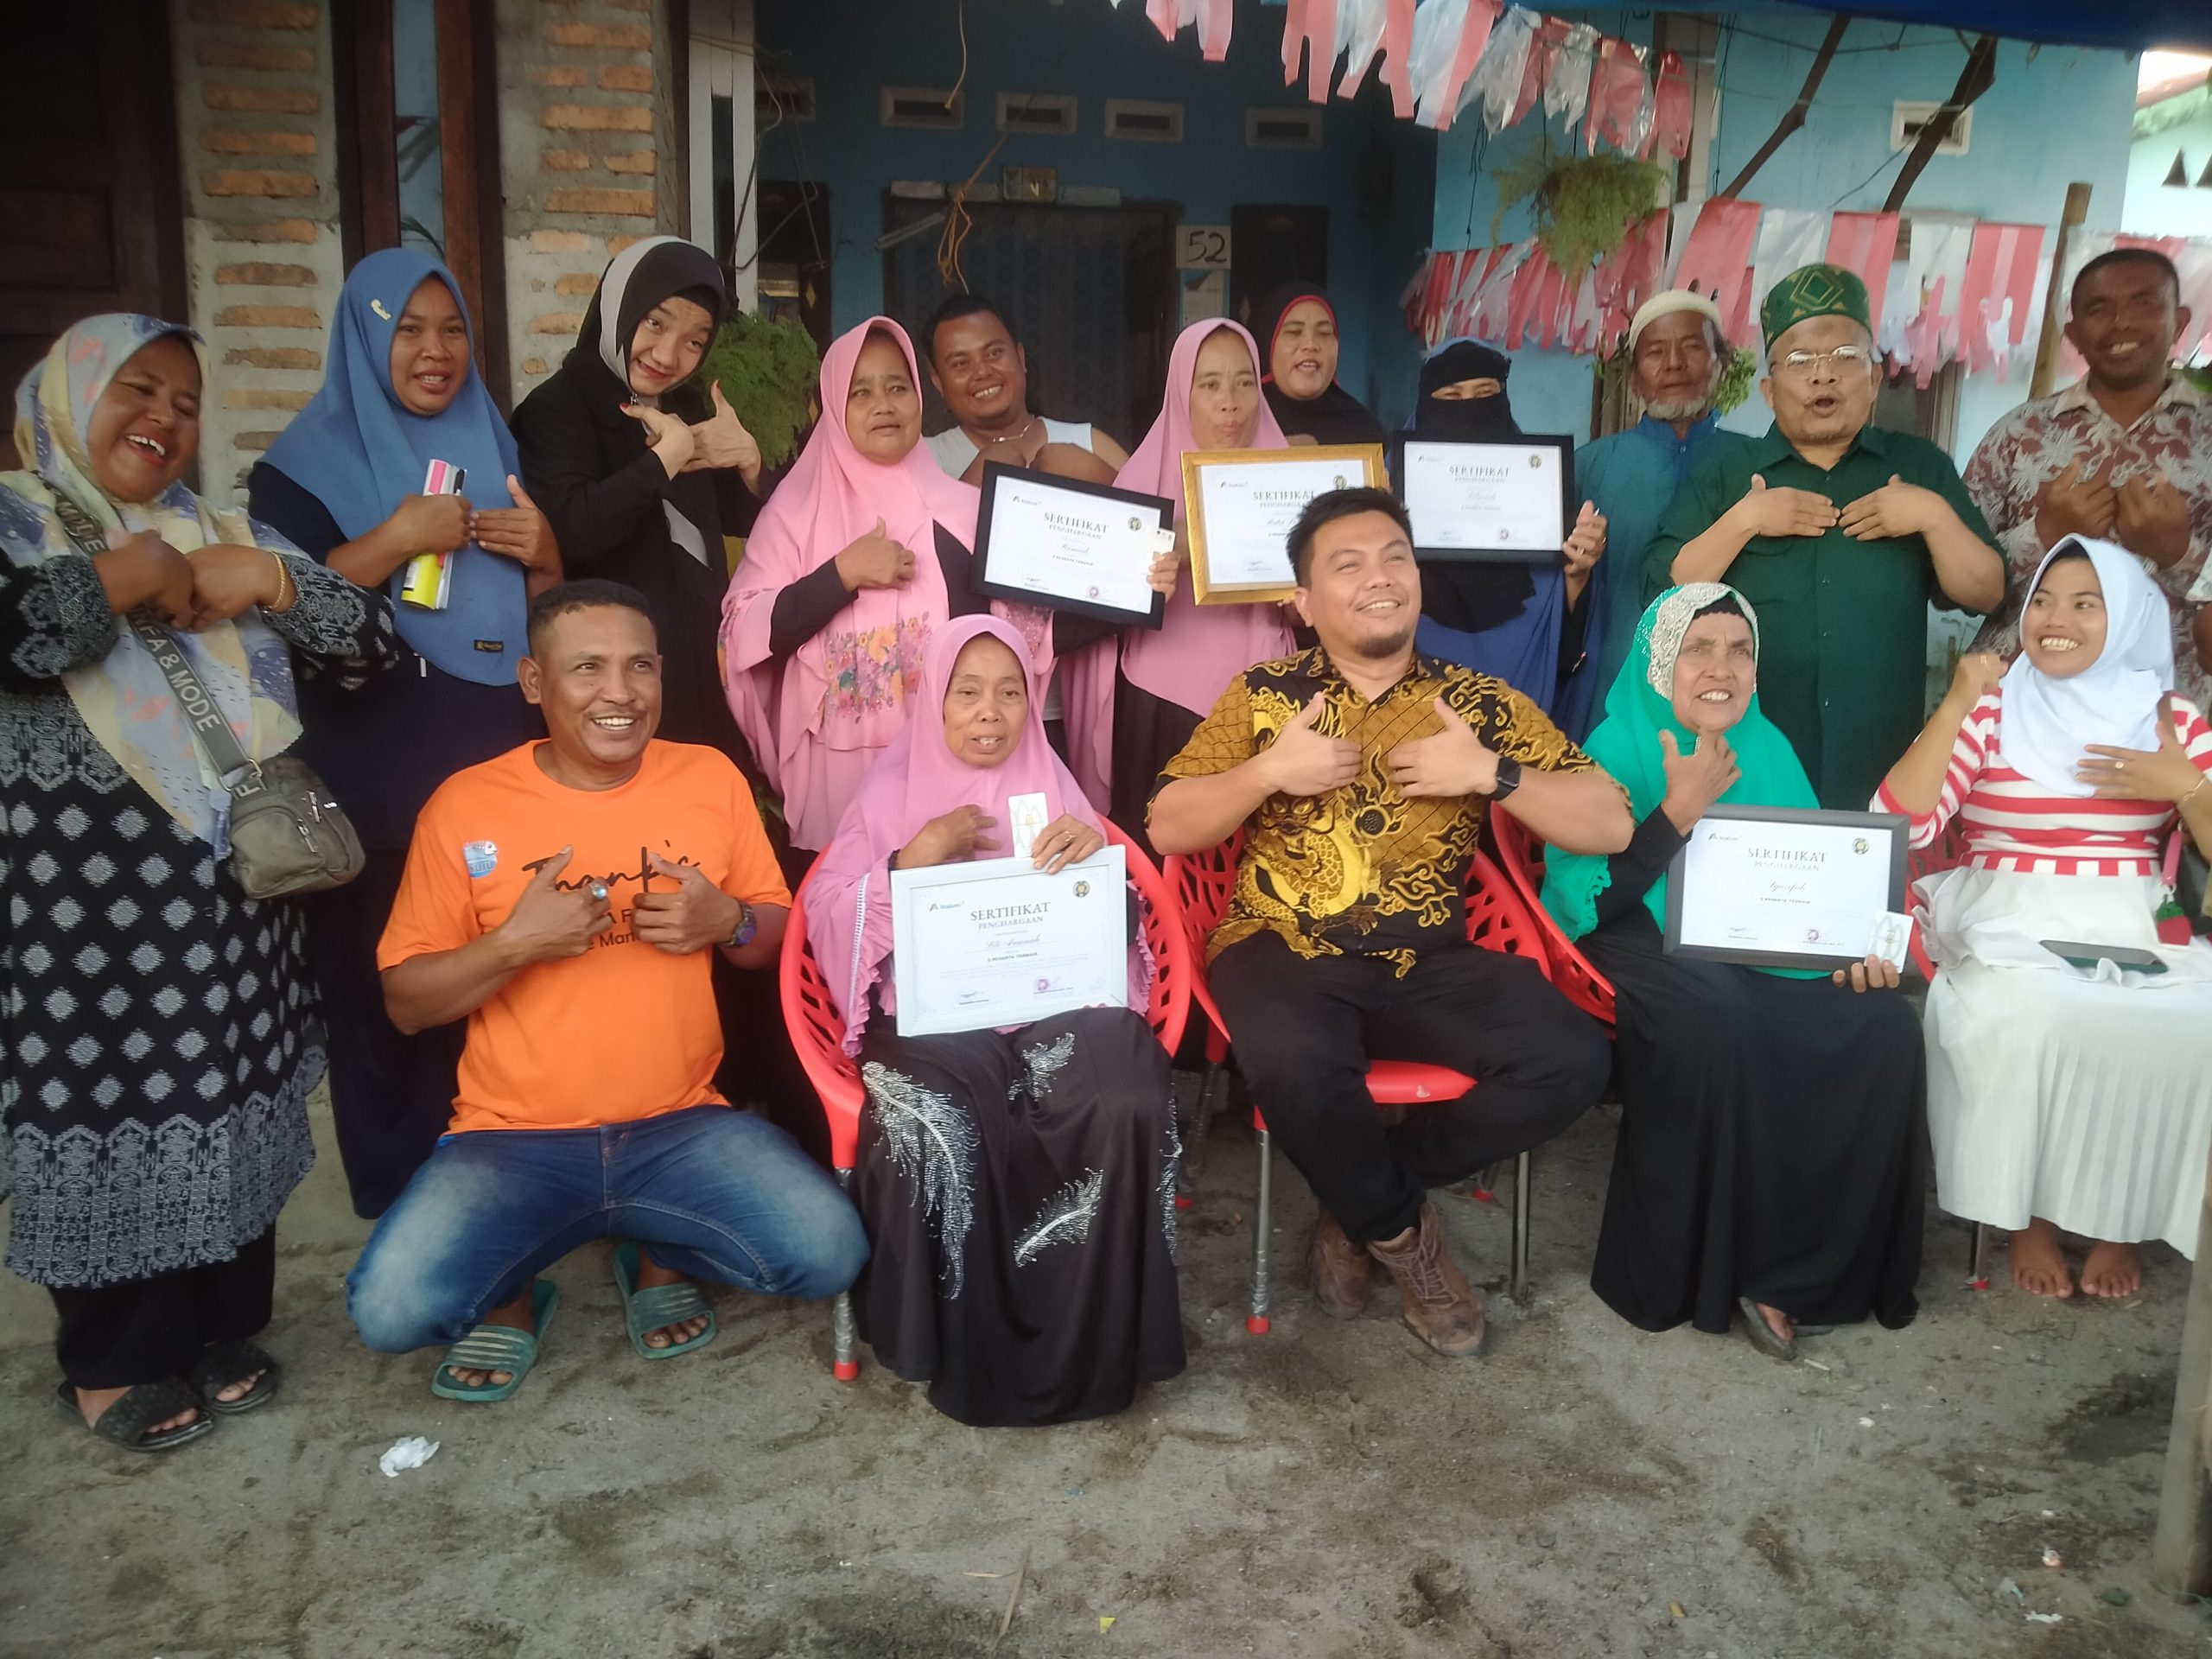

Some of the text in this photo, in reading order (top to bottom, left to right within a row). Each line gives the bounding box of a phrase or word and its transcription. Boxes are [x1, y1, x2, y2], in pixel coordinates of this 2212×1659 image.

[1187, 230, 1227, 264] 52
[1044, 512, 1109, 534] SERTIFIKAT
[168, 669, 221, 733] MODE
[1748, 848, 1827, 862] SERTIFIKAT
[970, 901, 1051, 922] SERTIFIKAT
[978, 915, 1044, 931] PENGHARGAAN
